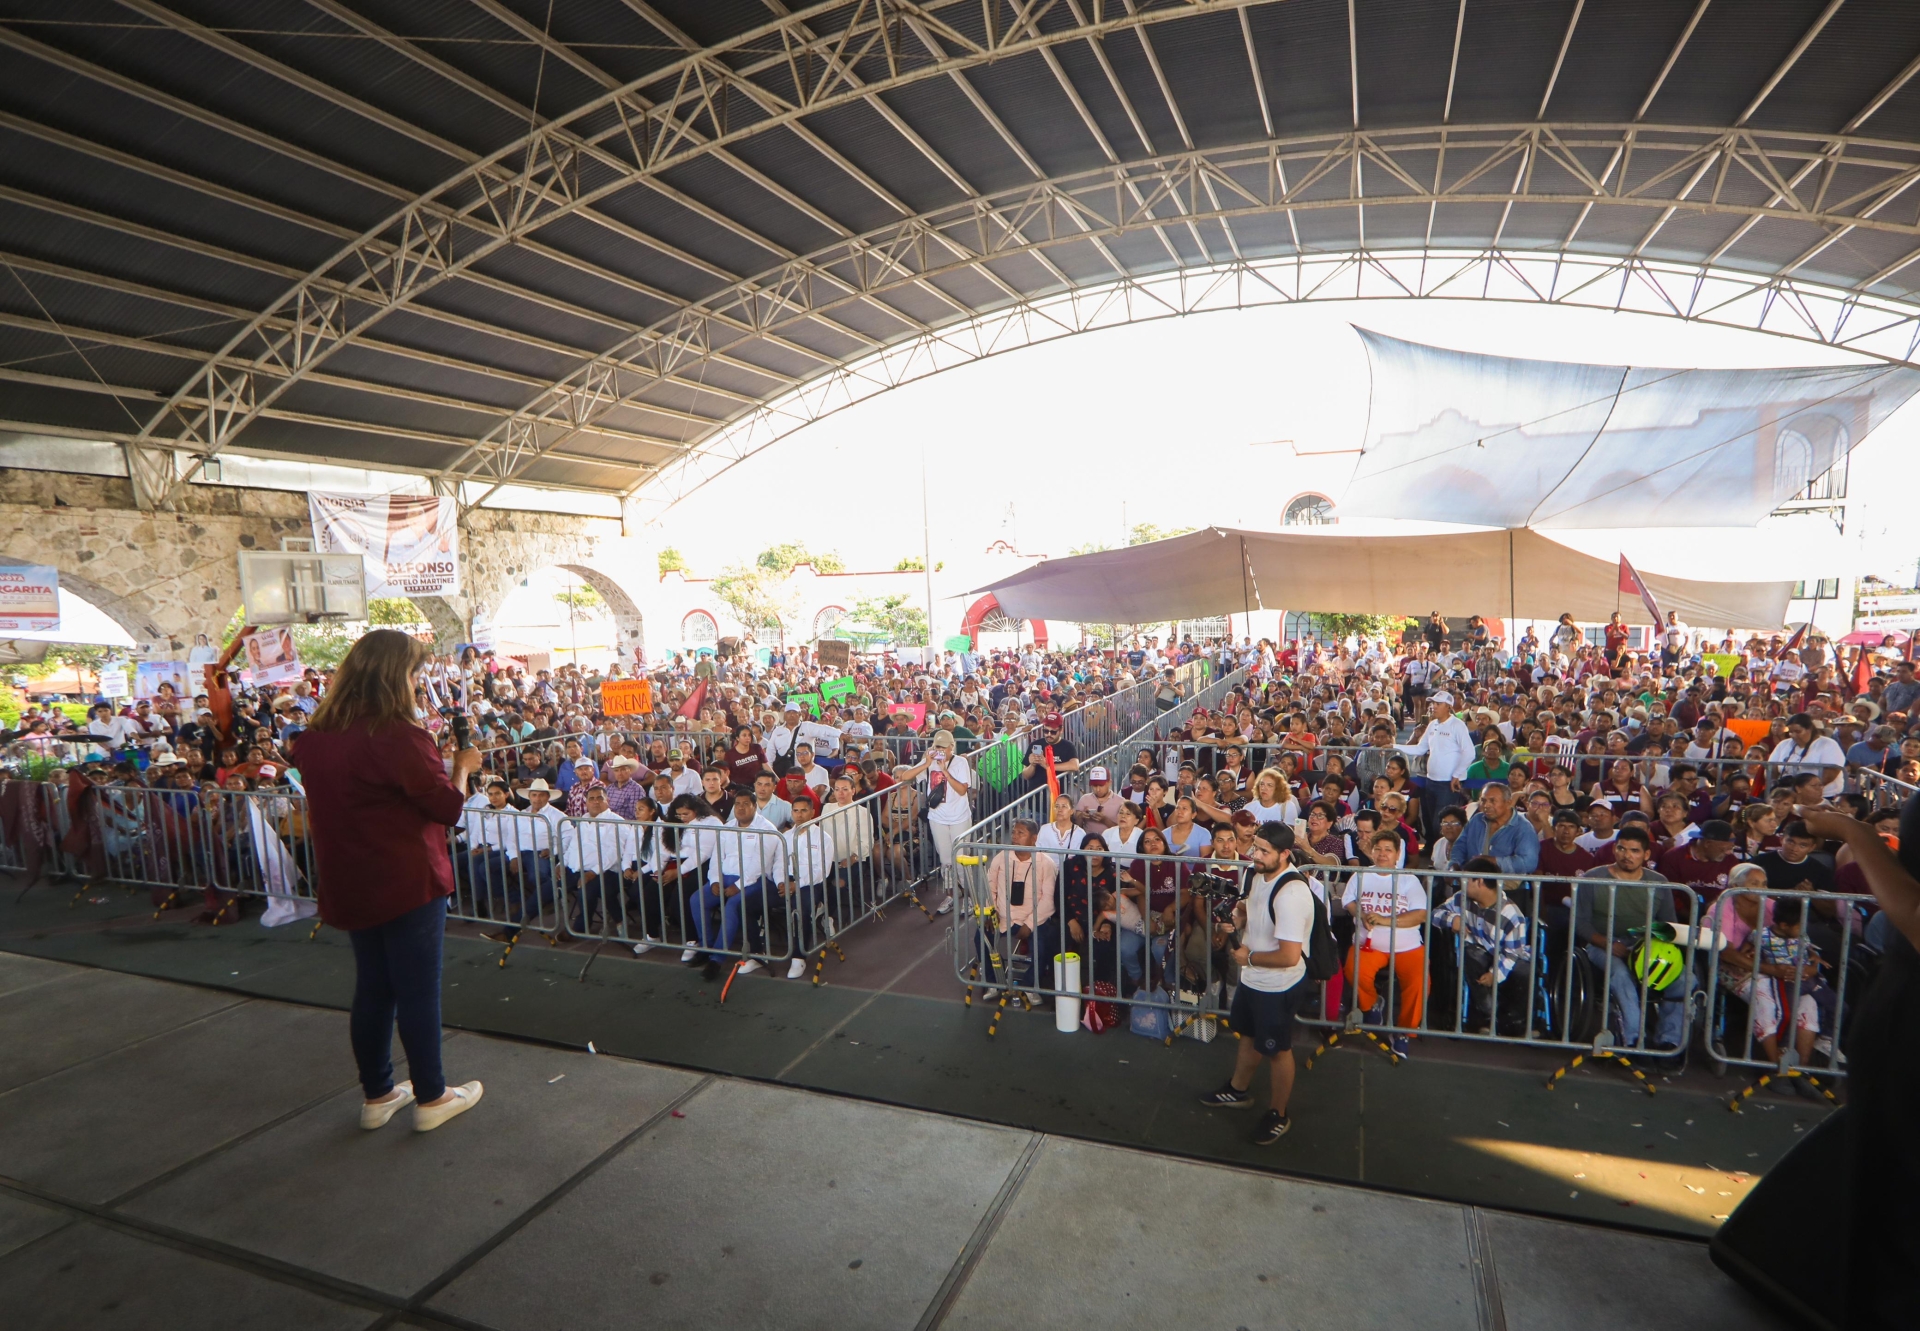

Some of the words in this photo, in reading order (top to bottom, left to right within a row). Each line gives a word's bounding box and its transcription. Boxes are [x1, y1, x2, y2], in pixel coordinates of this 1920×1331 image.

[318, 497, 367, 508] morena
[386, 561, 454, 574] ALFONSO
[387, 579, 418, 587] SOTELO
[603, 692, 651, 712] MORENA
[735, 754, 758, 766] morena
